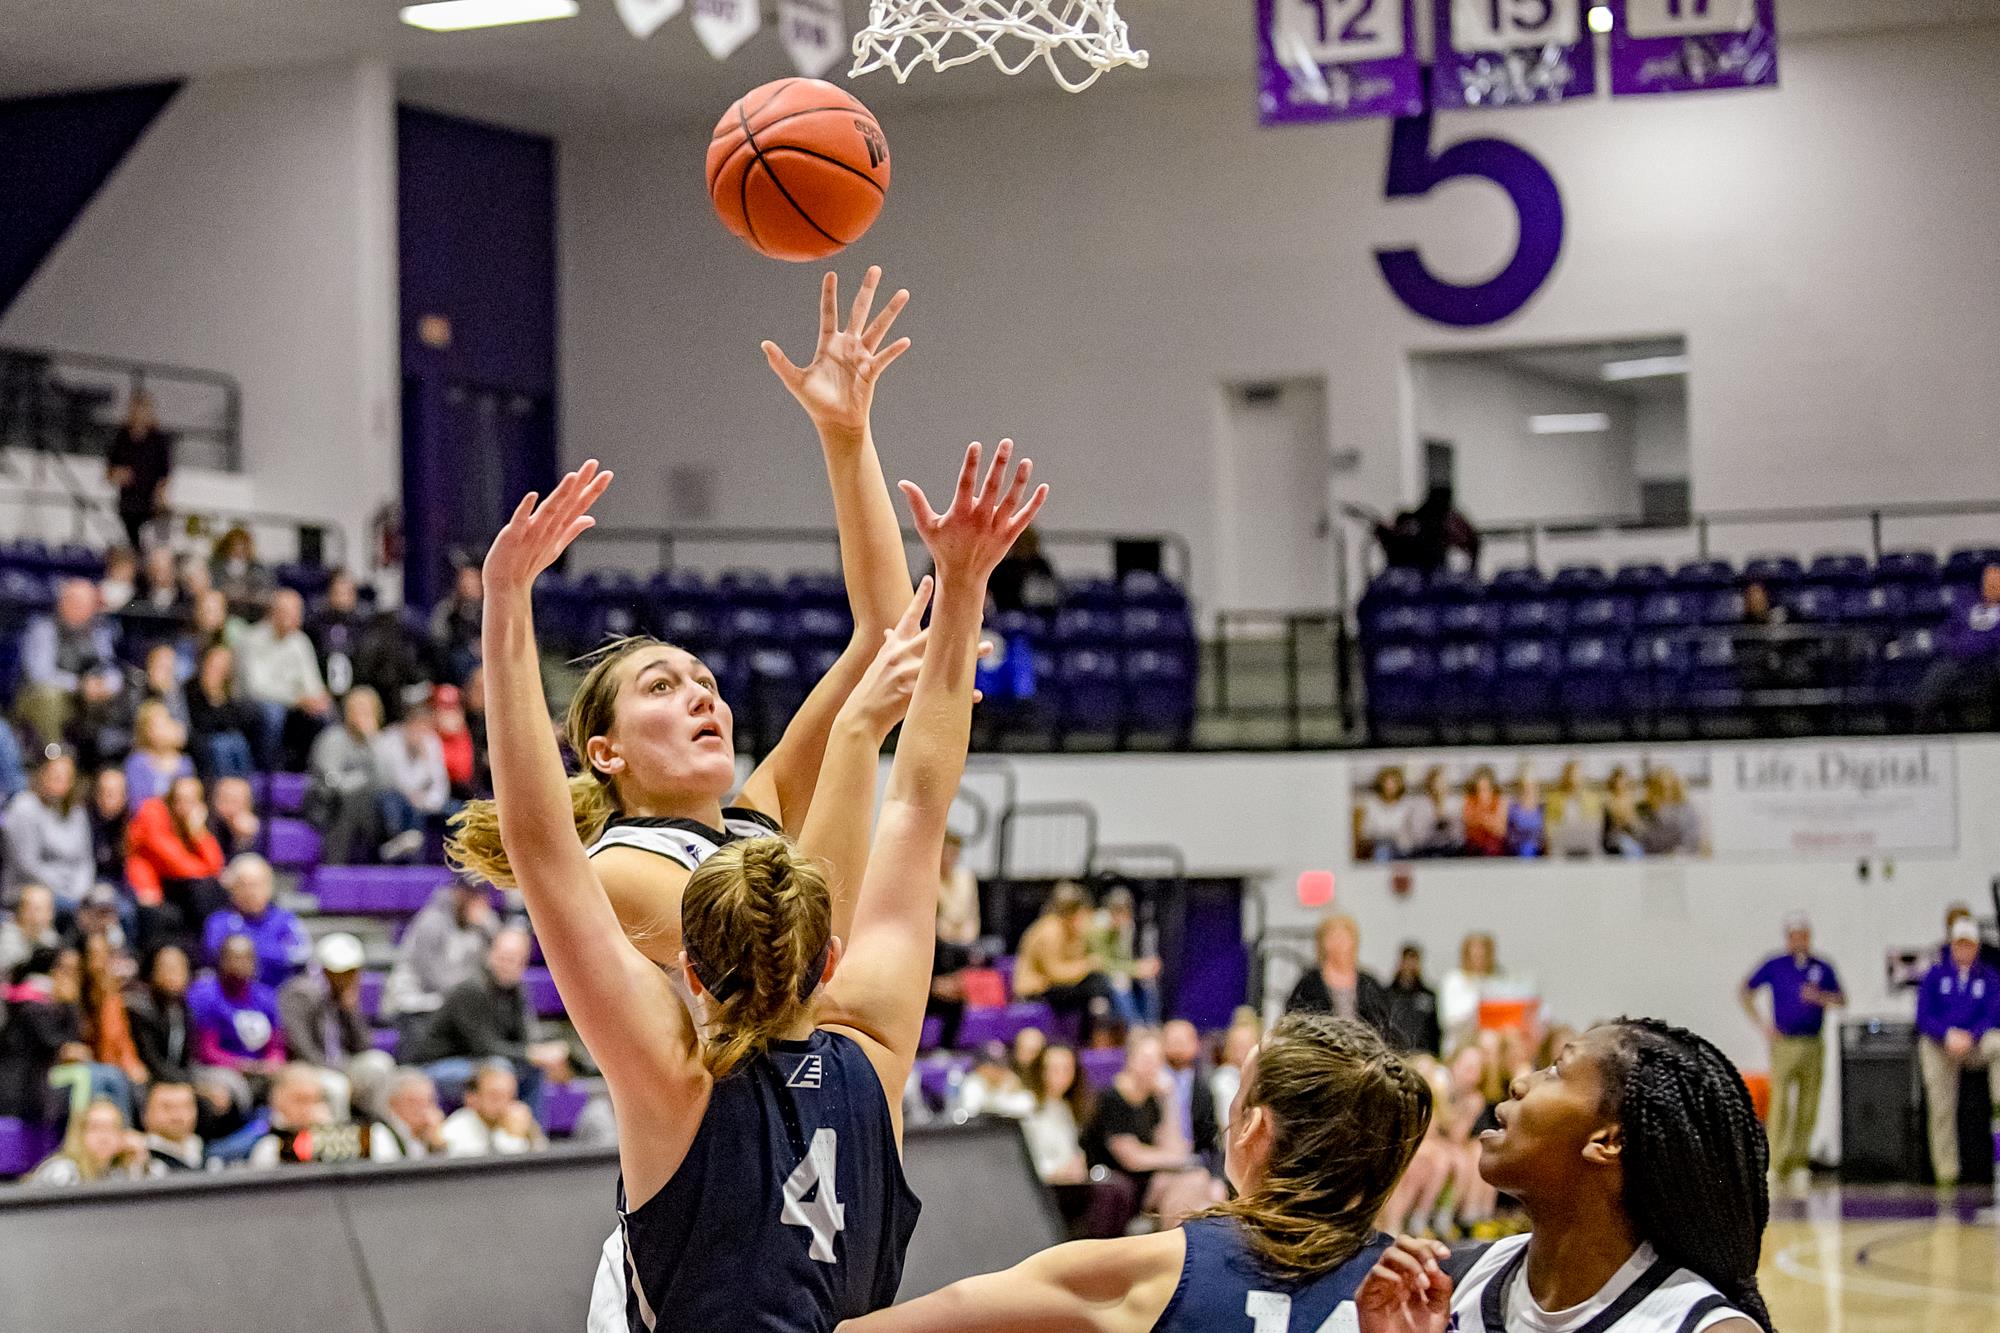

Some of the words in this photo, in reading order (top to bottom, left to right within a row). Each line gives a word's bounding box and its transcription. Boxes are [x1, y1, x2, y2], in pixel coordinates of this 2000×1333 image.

[1302, 0, 1377, 42] 12
[1372, 100, 1564, 327] 5
[779, 1127, 845, 1264] 4
[1245, 1290, 1361, 1333] 1
